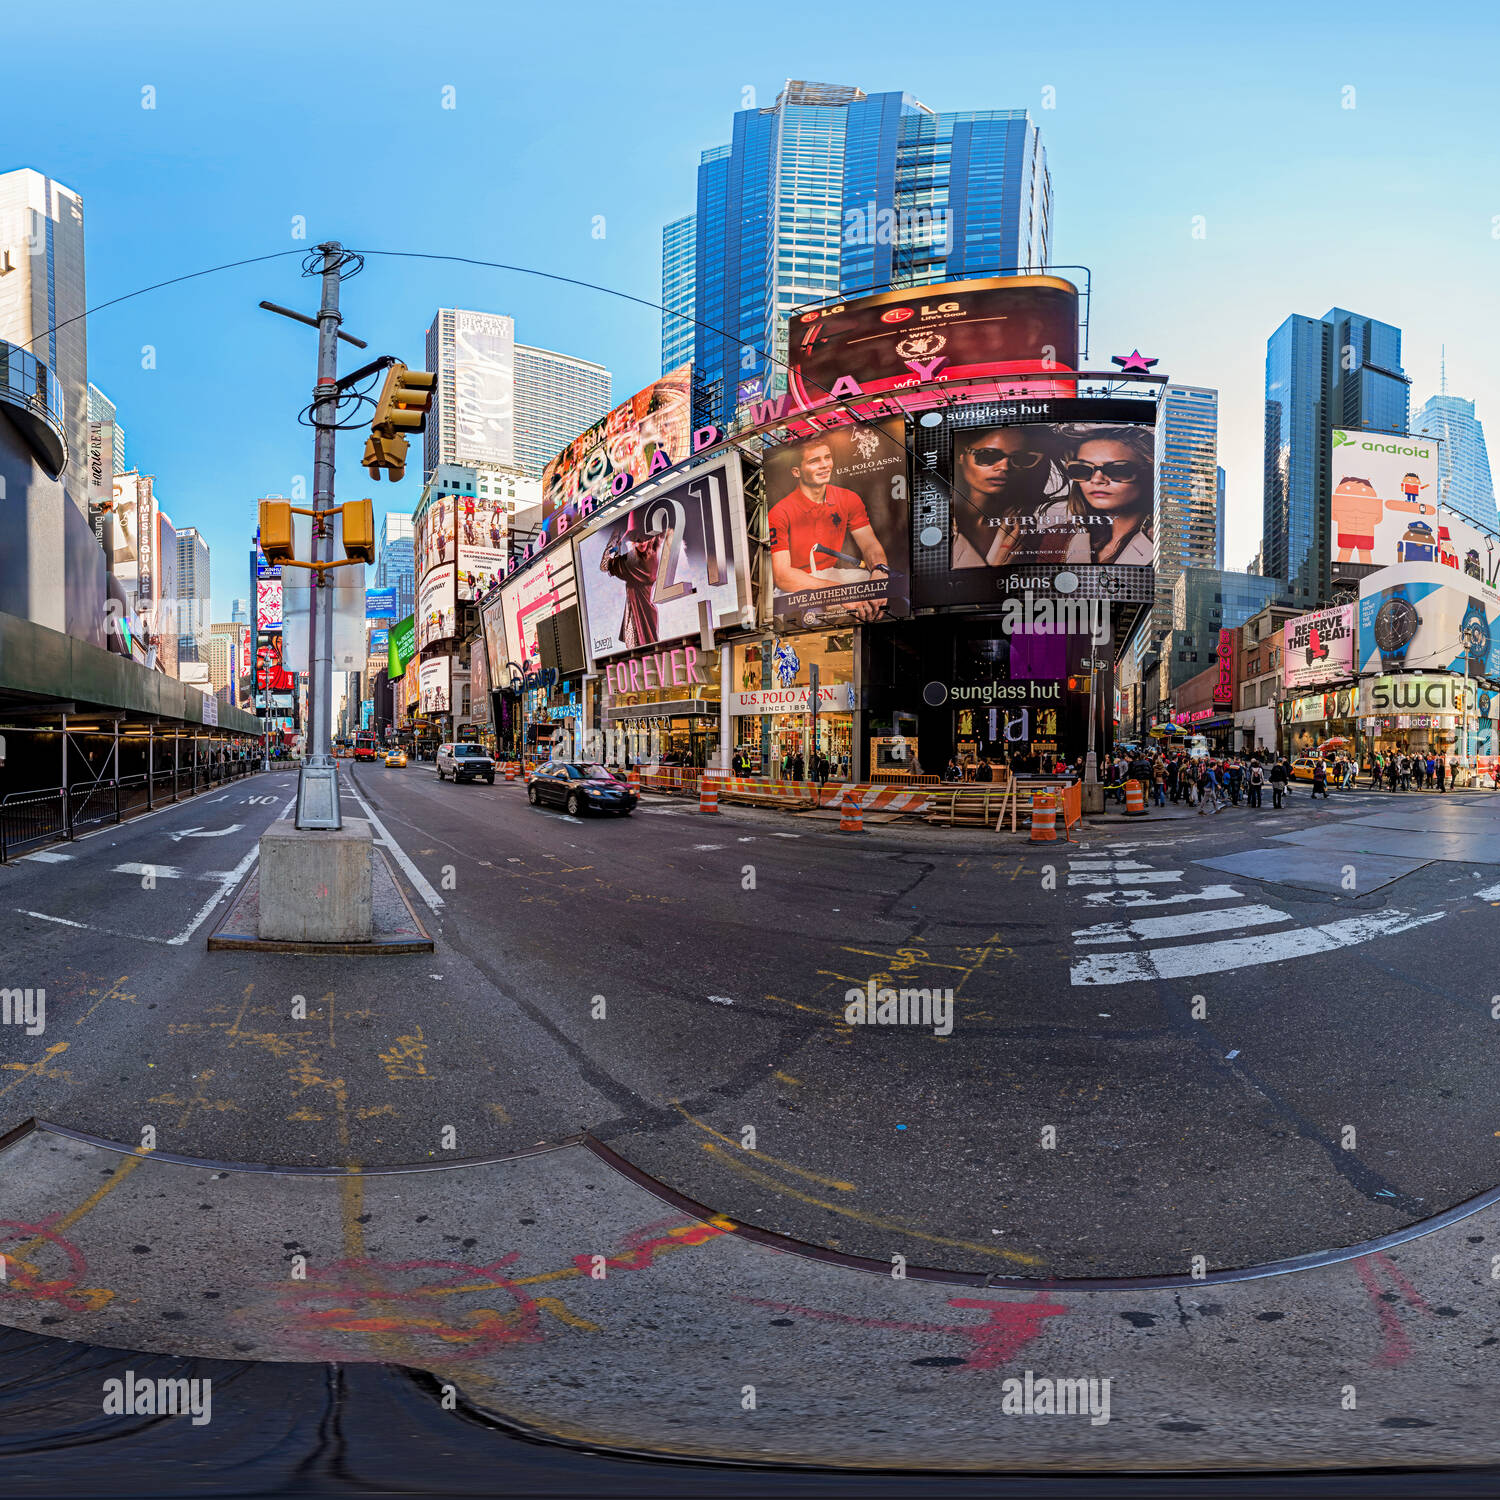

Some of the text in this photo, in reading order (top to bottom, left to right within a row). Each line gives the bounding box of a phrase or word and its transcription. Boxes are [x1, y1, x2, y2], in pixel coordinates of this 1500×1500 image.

[820, 305, 845, 318] LG
[921, 302, 960, 315] LG
[943, 311, 967, 319] Good
[946, 404, 1050, 420] sunglass hut
[556, 356, 949, 534] BROADWAY
[1361, 441, 1430, 459] android
[836, 457, 903, 475] U.S. POLO ASSN.
[924, 449, 938, 472] hut
[988, 515, 1120, 528] BURBERRY
[140, 489, 151, 594] TIMES SQUARE
[788, 581, 889, 606] LIVE AUTHENTICALLY
[1294, 615, 1343, 637] RESERVE
[1287, 626, 1351, 650] THIS SEAT!
[606, 646, 700, 696] FOREVER
[1214, 630, 1233, 699] BOND 45
[740, 688, 838, 706] U.S. POLO ASN.
[951, 681, 1060, 703] sunglass hut
[760, 705, 786, 713] SINCE
[624, 716, 660, 730] FOREVER
